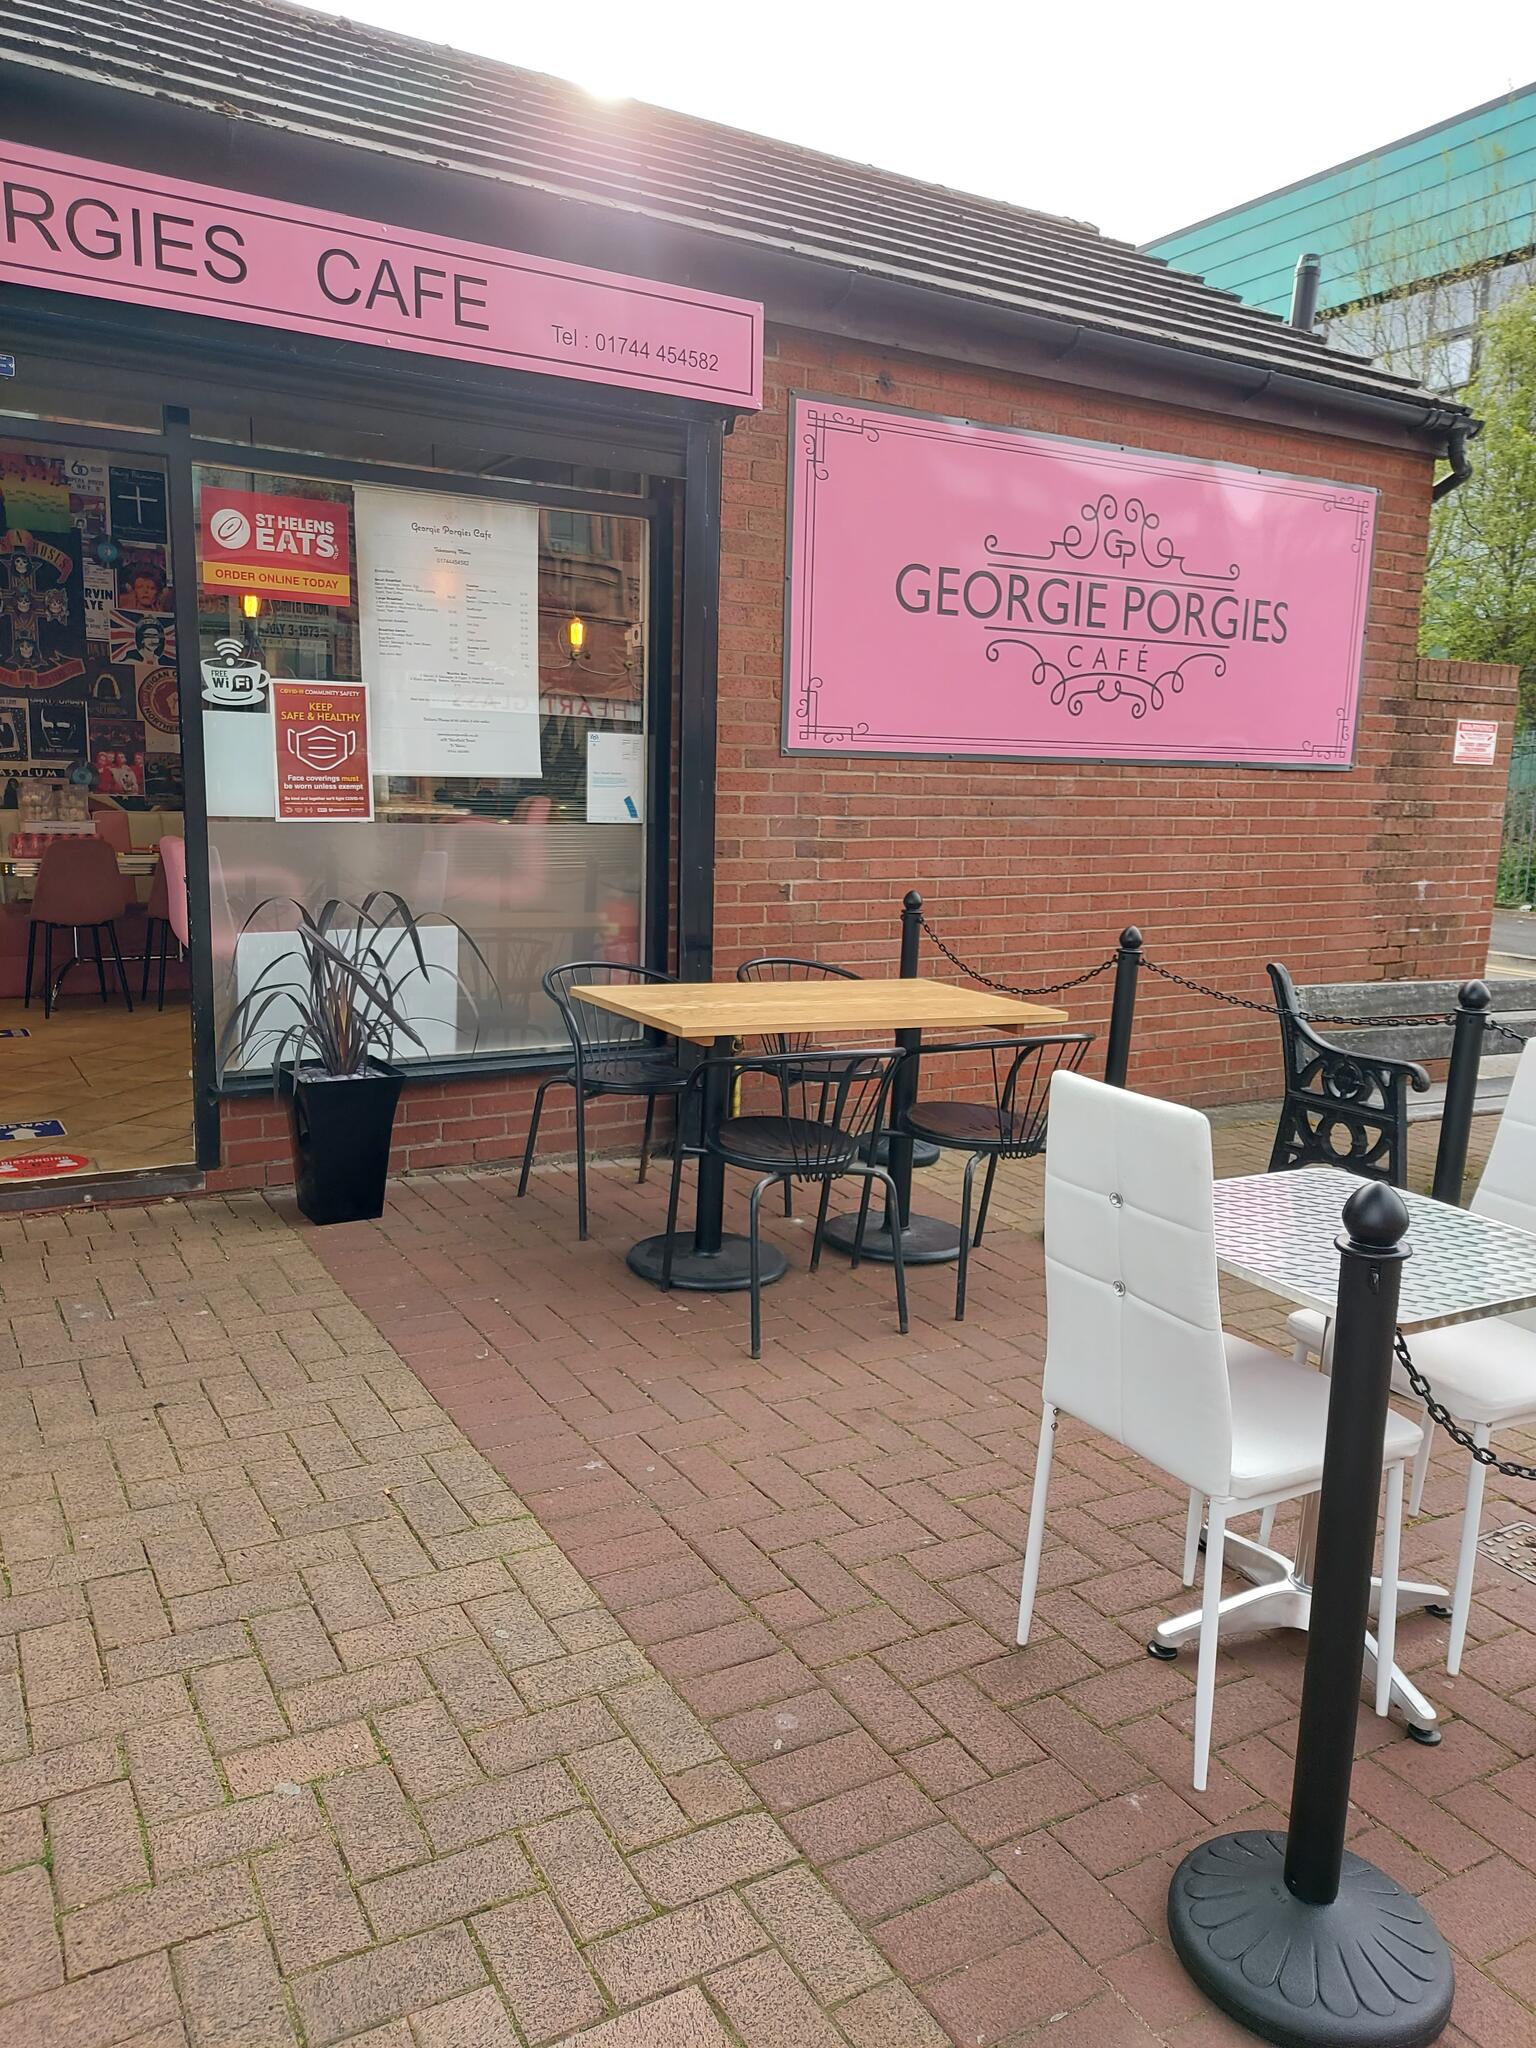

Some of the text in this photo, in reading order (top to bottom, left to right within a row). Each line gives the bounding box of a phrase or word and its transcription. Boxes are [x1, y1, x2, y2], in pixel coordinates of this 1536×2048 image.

[3, 181, 490, 331] RGIES CAFE
[551, 324, 577, 347] Tel
[595, 332, 650, 359] 01744
[656, 344, 719, 372] 454582
[255, 513, 334, 535] ST HELENS
[411, 522, 493, 541] Georgie Porgies Cafe
[256, 528, 335, 558] EATS
[215, 569, 339, 589] ORDER ONLINE TODAY
[895, 563, 1289, 644] GEORGIE PORGIES
[1067, 644, 1148, 673] CAFÉ
[281, 712, 361, 722] SAFE & HEALTHY
[309, 702, 333, 711] KEEP
[305, 775, 340, 783] coverings
